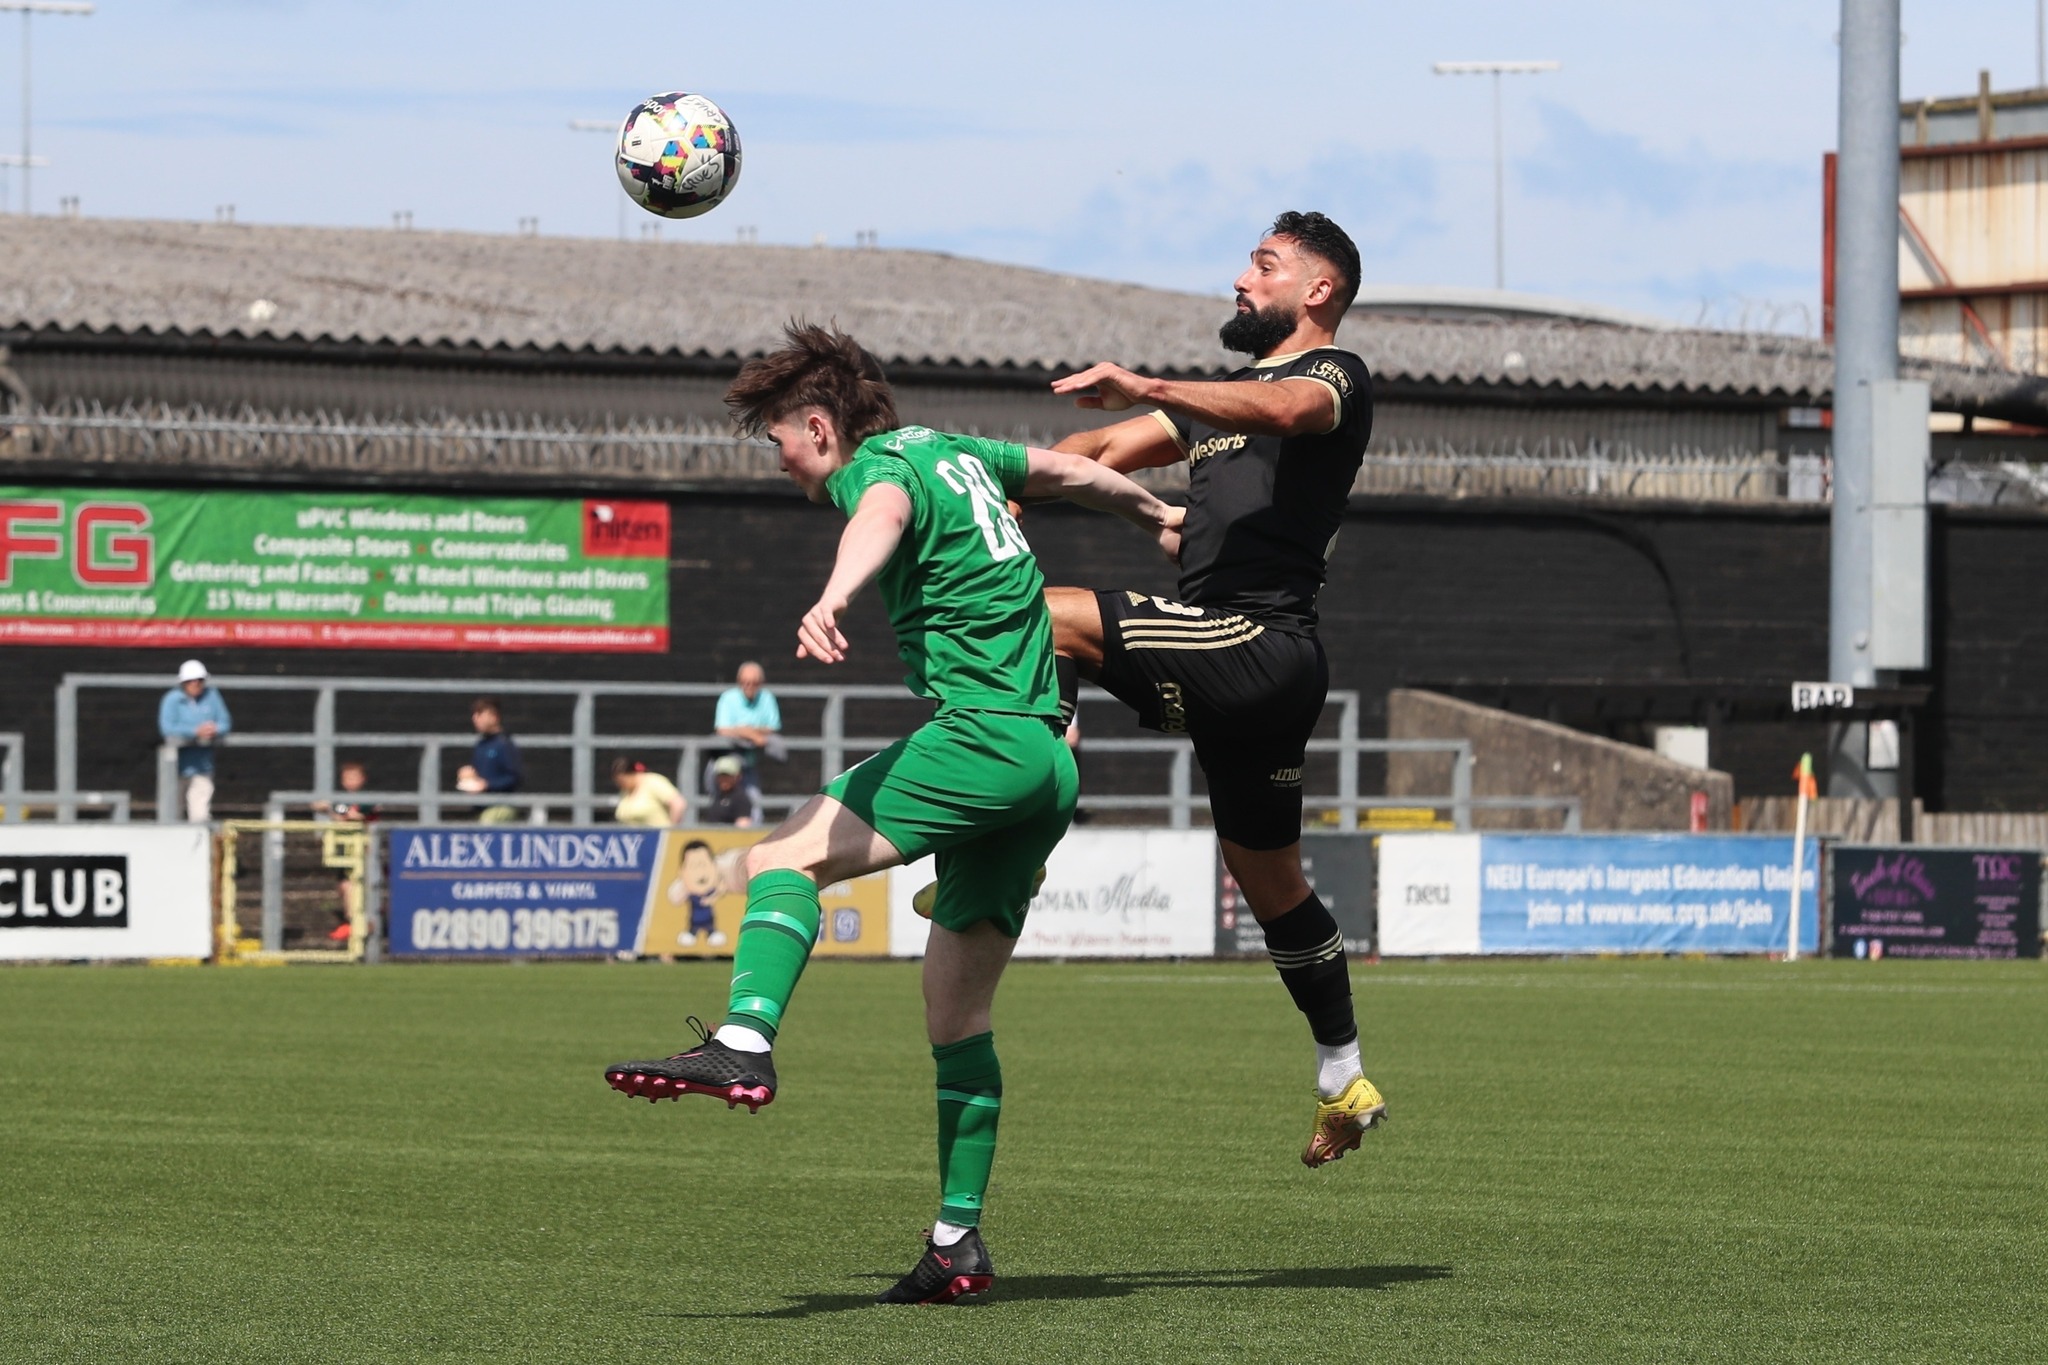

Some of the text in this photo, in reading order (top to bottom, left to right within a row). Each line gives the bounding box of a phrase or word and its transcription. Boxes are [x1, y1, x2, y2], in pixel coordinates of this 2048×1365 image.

[296, 508, 527, 533] uPVC Windows and Doors
[254, 533, 411, 559] Composite Doors
[431, 538, 569, 562] Conservatories
[170, 560, 369, 587] Guttering and Fascias
[416, 565, 469, 586] Rated
[472, 566, 553, 588] Windows
[557, 568, 592, 589] and
[594, 569, 649, 590] Doors
[232, 588, 272, 610] Year
[275, 588, 363, 615] Warranty
[383, 591, 615, 621] Double and Triple Glazing
[403, 833, 646, 868] ALEX LINDSAY
[452, 881, 524, 899] CARPETS
[527, 881, 541, 899] &
[1485, 863, 1814, 895] NEU Europe's largest Education Unin
[1404, 883, 1449, 905] neu
[1526, 900, 1562, 929] join
[1564, 900, 1585, 924] at
[412, 908, 619, 949] 02890 396175
